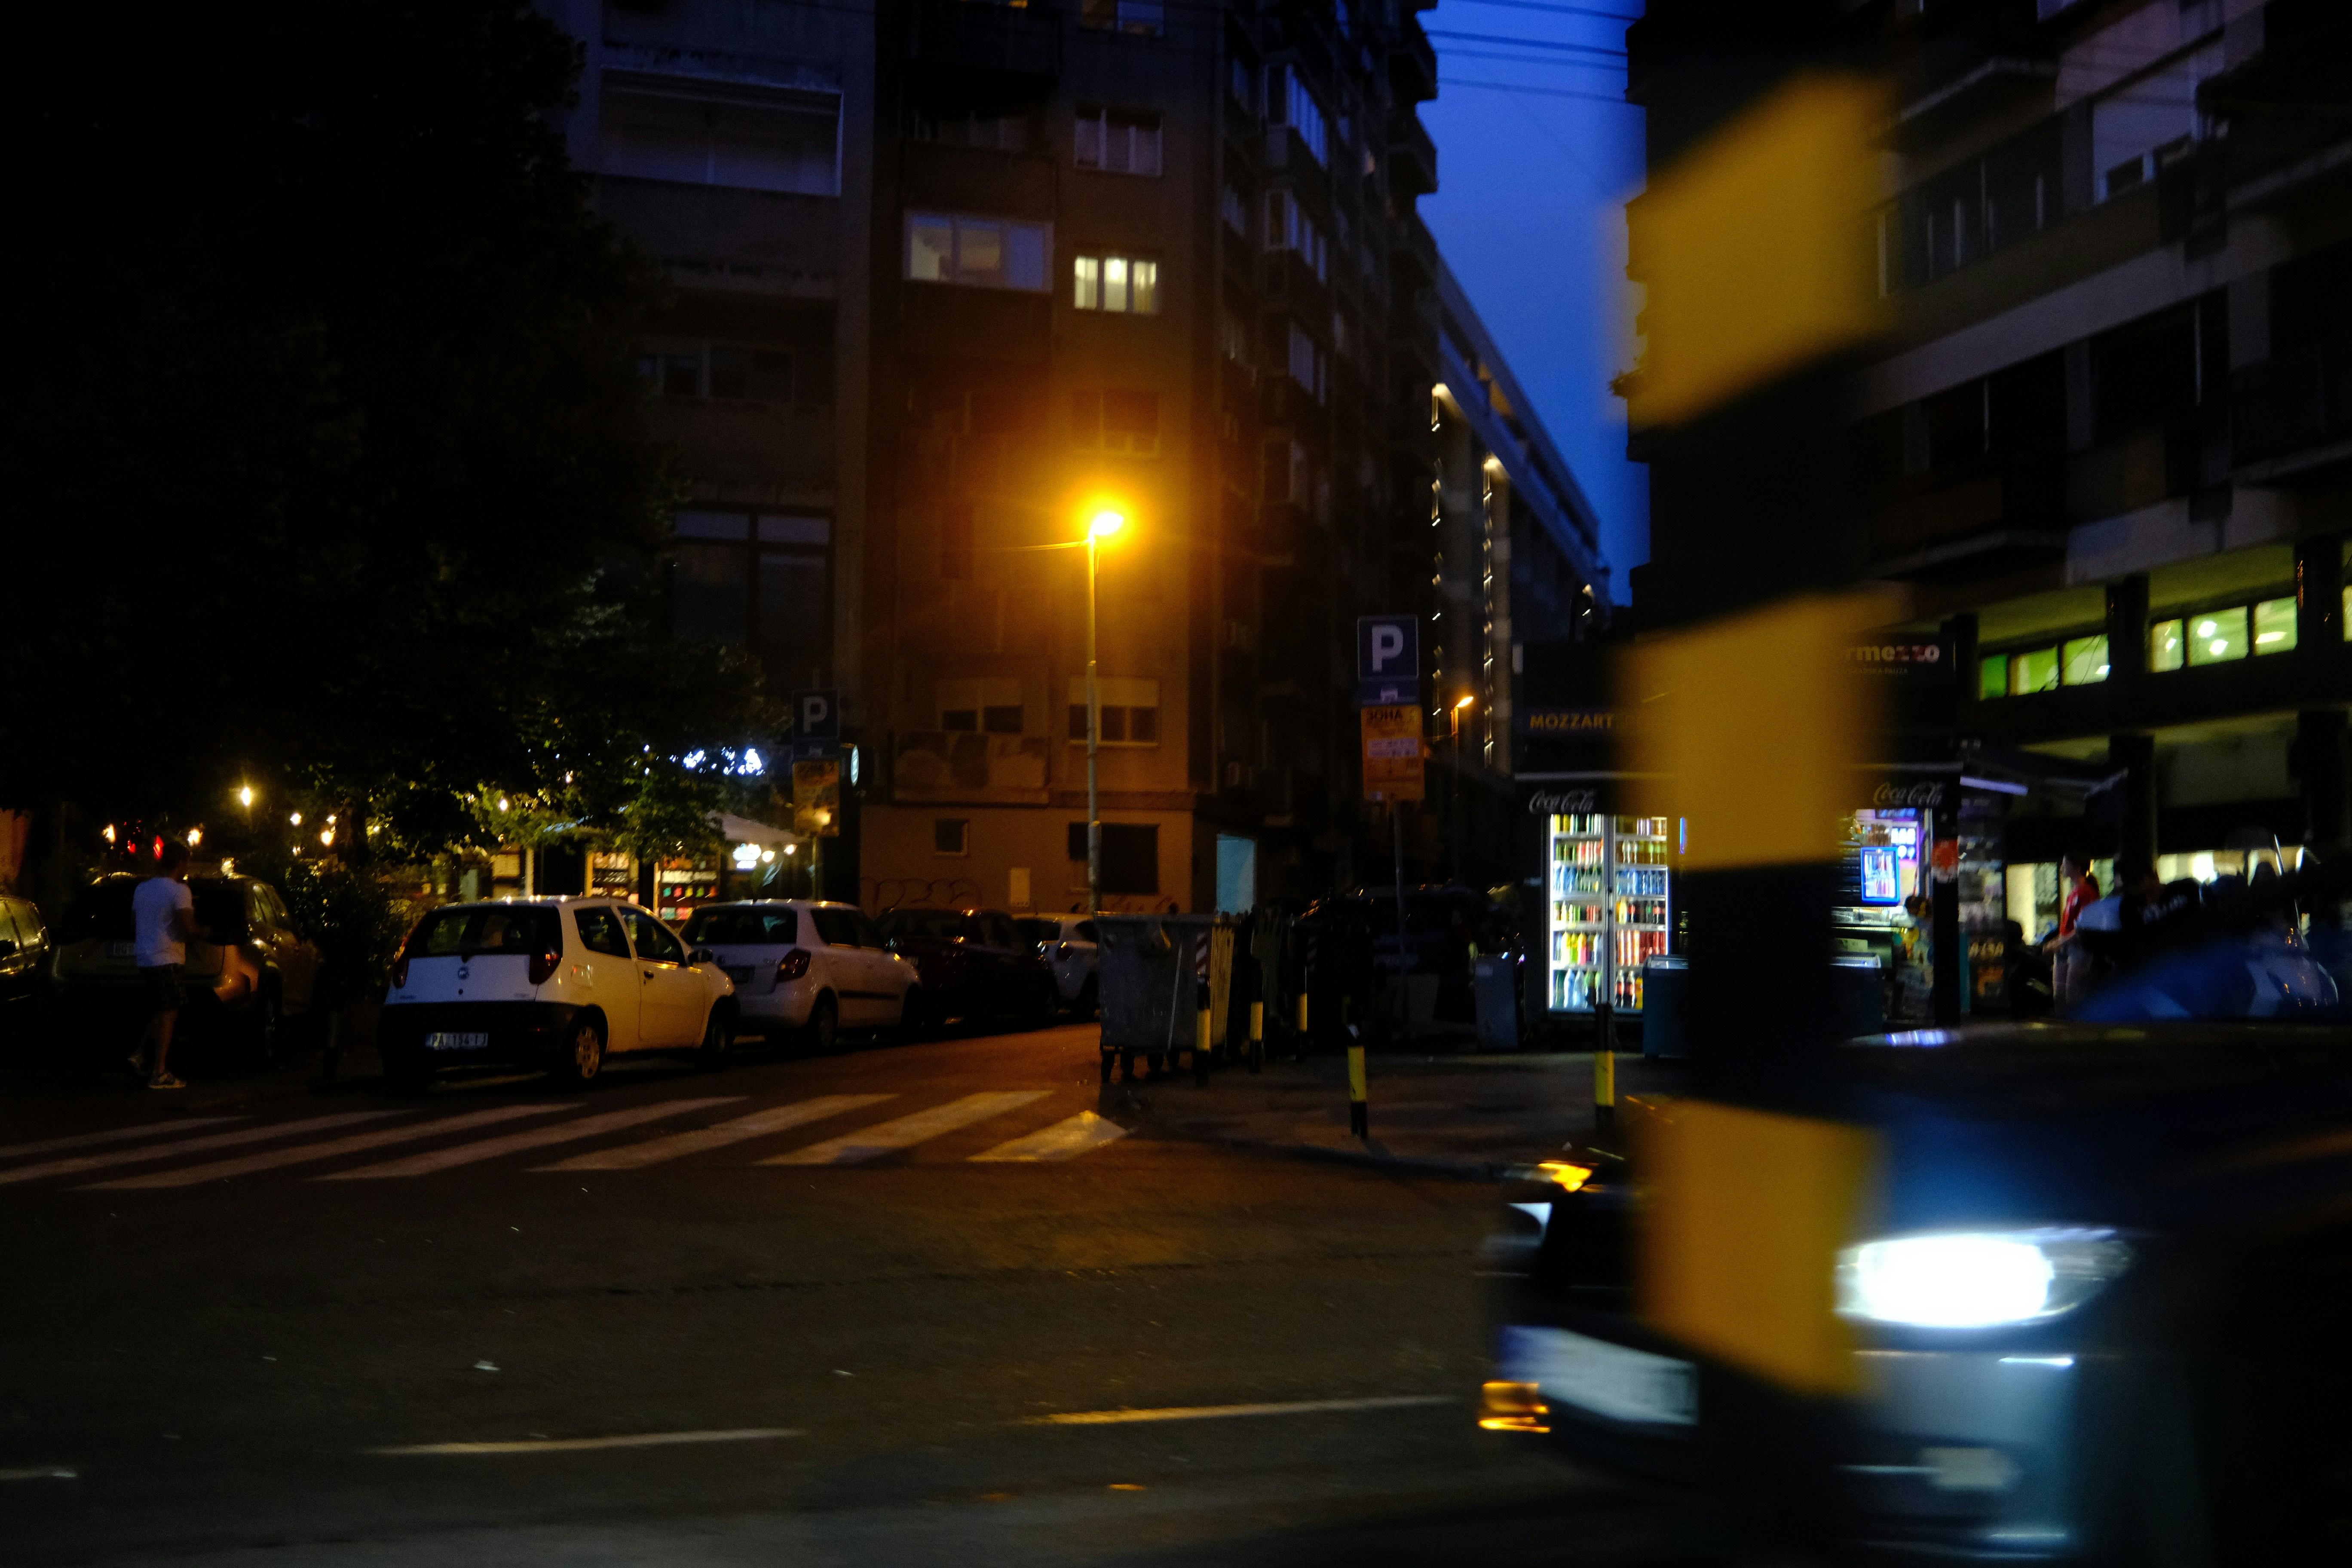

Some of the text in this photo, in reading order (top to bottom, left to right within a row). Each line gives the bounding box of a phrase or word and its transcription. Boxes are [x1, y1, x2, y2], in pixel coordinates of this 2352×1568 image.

[1372, 624, 1403, 673] P
[802, 696, 828, 733] P
[1530, 713, 1615, 730] MOZZART
